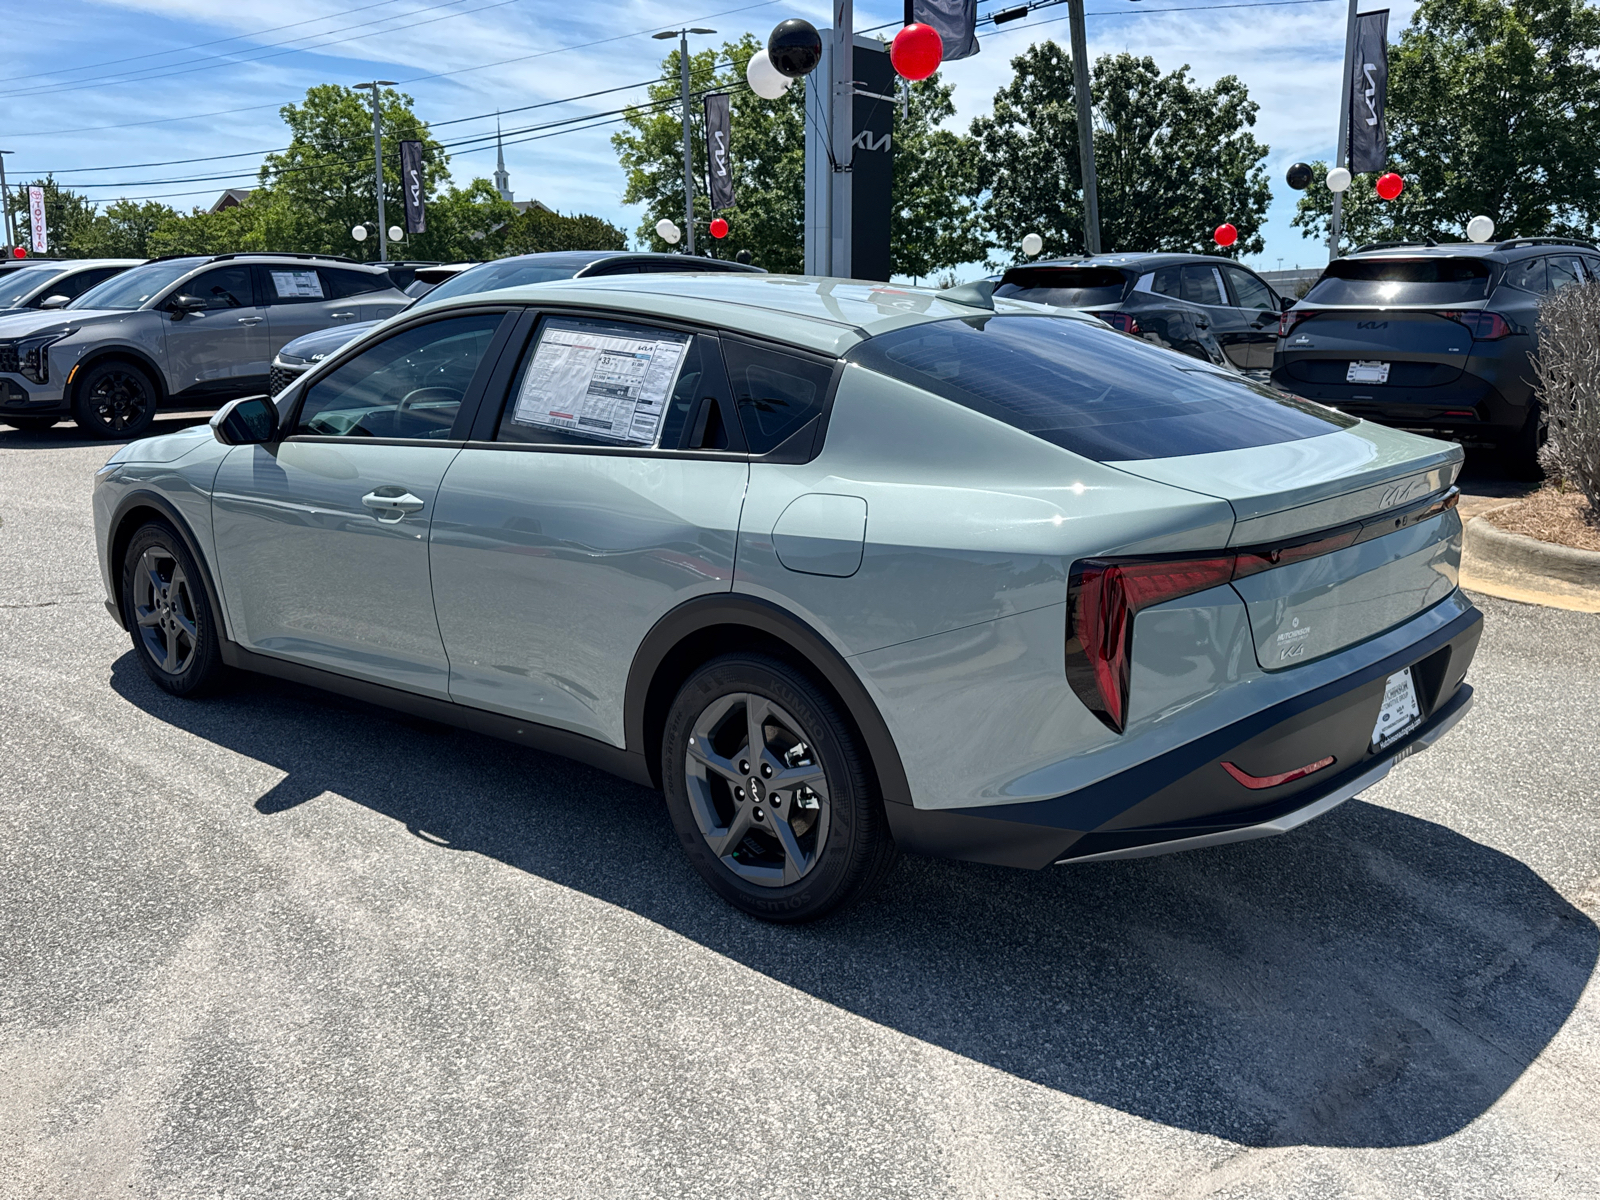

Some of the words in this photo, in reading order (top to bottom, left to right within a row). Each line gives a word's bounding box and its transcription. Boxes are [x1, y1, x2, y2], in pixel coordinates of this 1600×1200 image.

[34, 201, 43, 248] TOYOTA
[601, 356, 611, 365] 33
[1277, 626, 1310, 641] HUTCHINSON
[1280, 643, 1304, 660] K4
[770, 680, 825, 740] KUMHO
[756, 890, 811, 911] SOLUS
